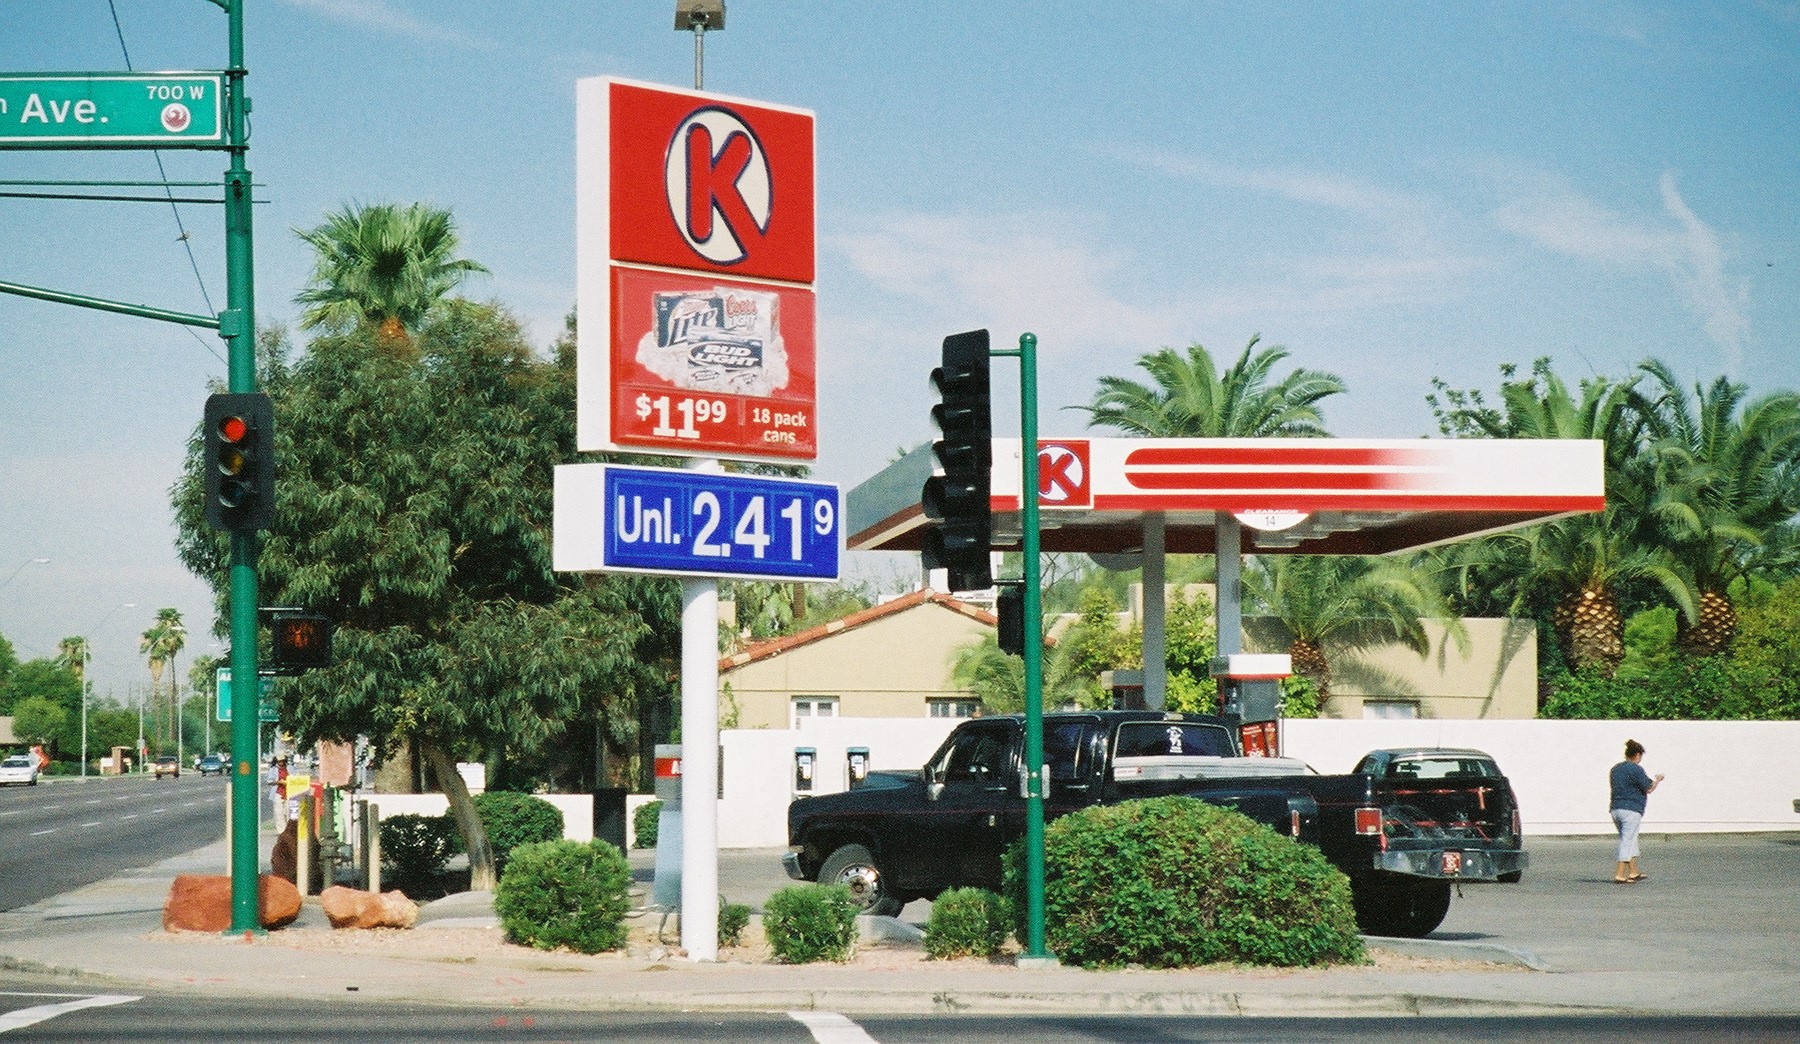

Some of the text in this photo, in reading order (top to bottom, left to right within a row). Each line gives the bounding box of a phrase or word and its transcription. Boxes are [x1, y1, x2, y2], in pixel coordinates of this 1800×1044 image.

[146, 85, 204, 100] 700 W
[20, 92, 109, 124] Ave.
[684, 121, 768, 259] K
[694, 352, 760, 367] LIGHT
[703, 343, 752, 357] BUD
[752, 407, 807, 429] 18 pack
[763, 428, 797, 445] cans
[1037, 452, 1080, 500] K
[617, 494, 682, 545] Unl.
